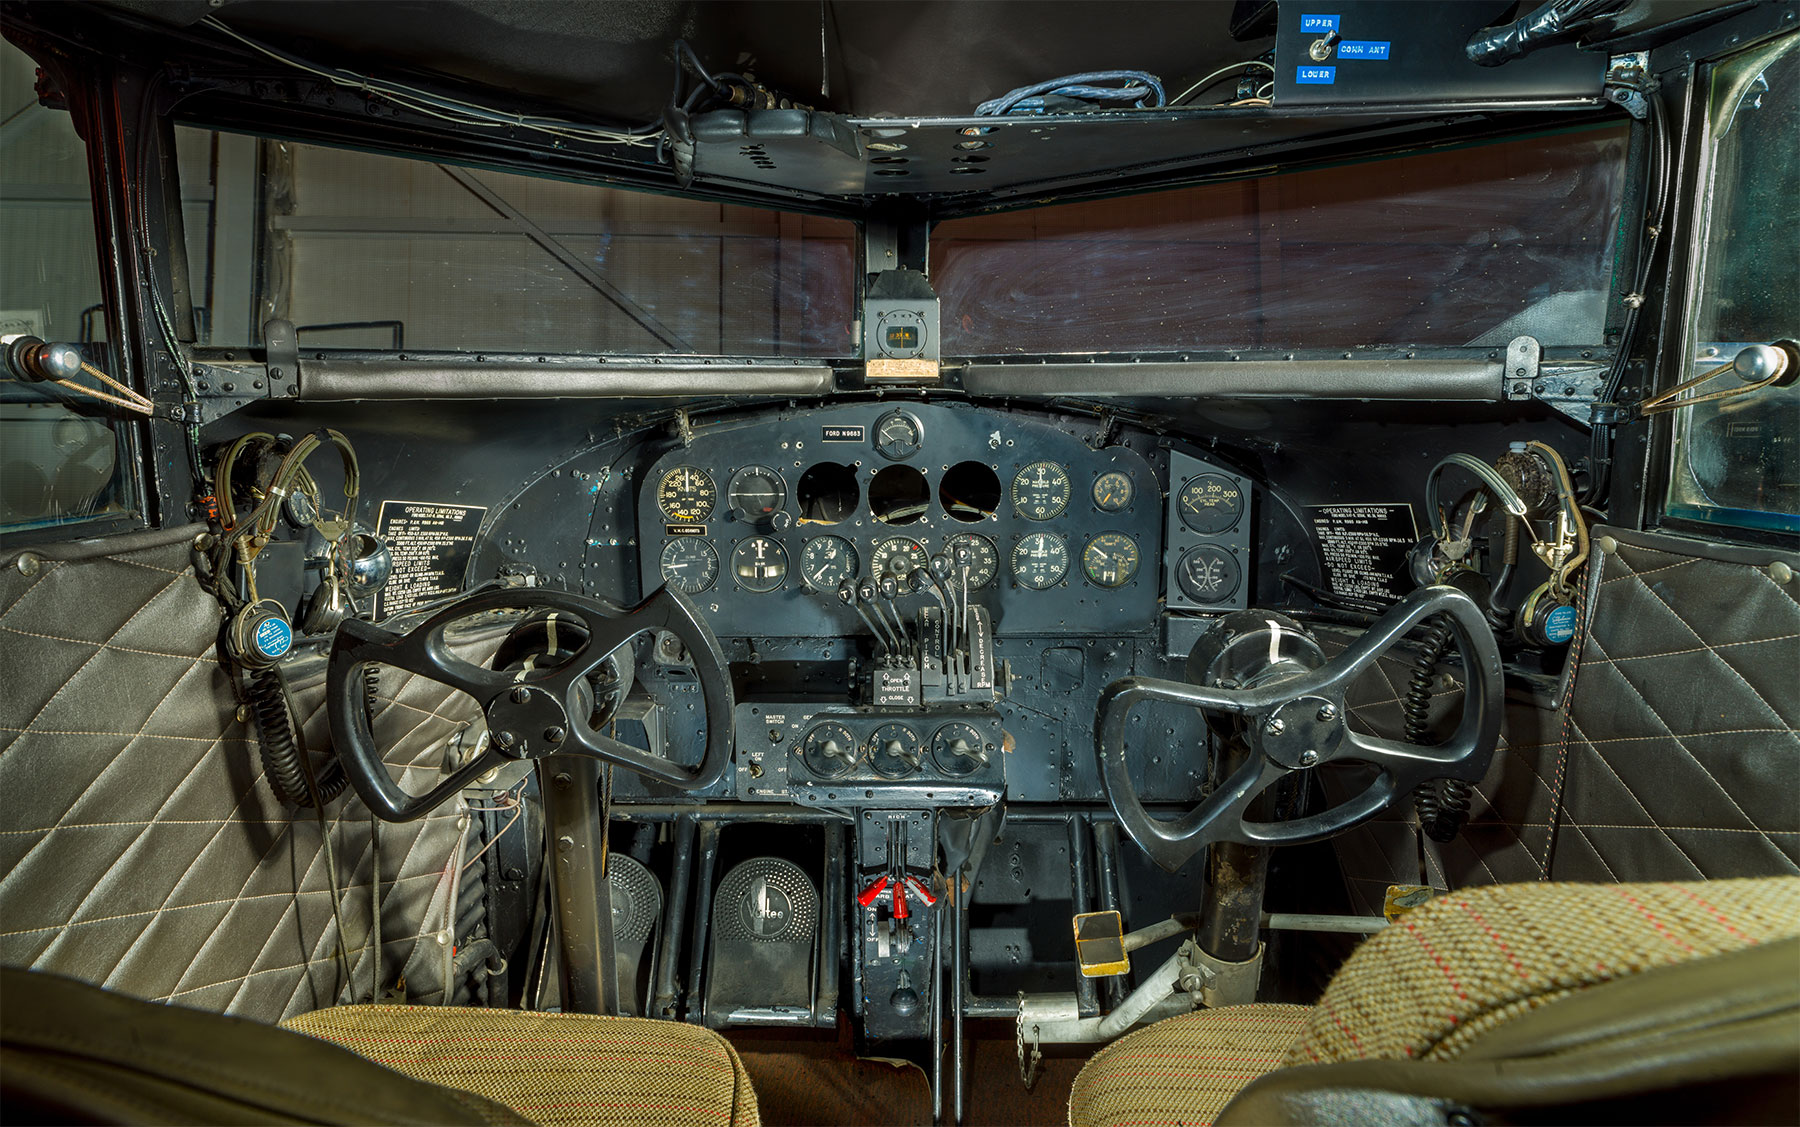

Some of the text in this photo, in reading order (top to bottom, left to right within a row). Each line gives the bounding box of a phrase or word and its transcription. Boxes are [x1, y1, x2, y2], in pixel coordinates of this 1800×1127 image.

[1305, 19, 1332, 27] UPPER
[1368, 46, 1386, 54] ANT
[1302, 70, 1330, 78] LOWER
[435, 508, 467, 516] LIMITATIONS
[884, 582, 892, 591] T
[840, 590, 848, 598] T
[863, 588, 871, 597] T
